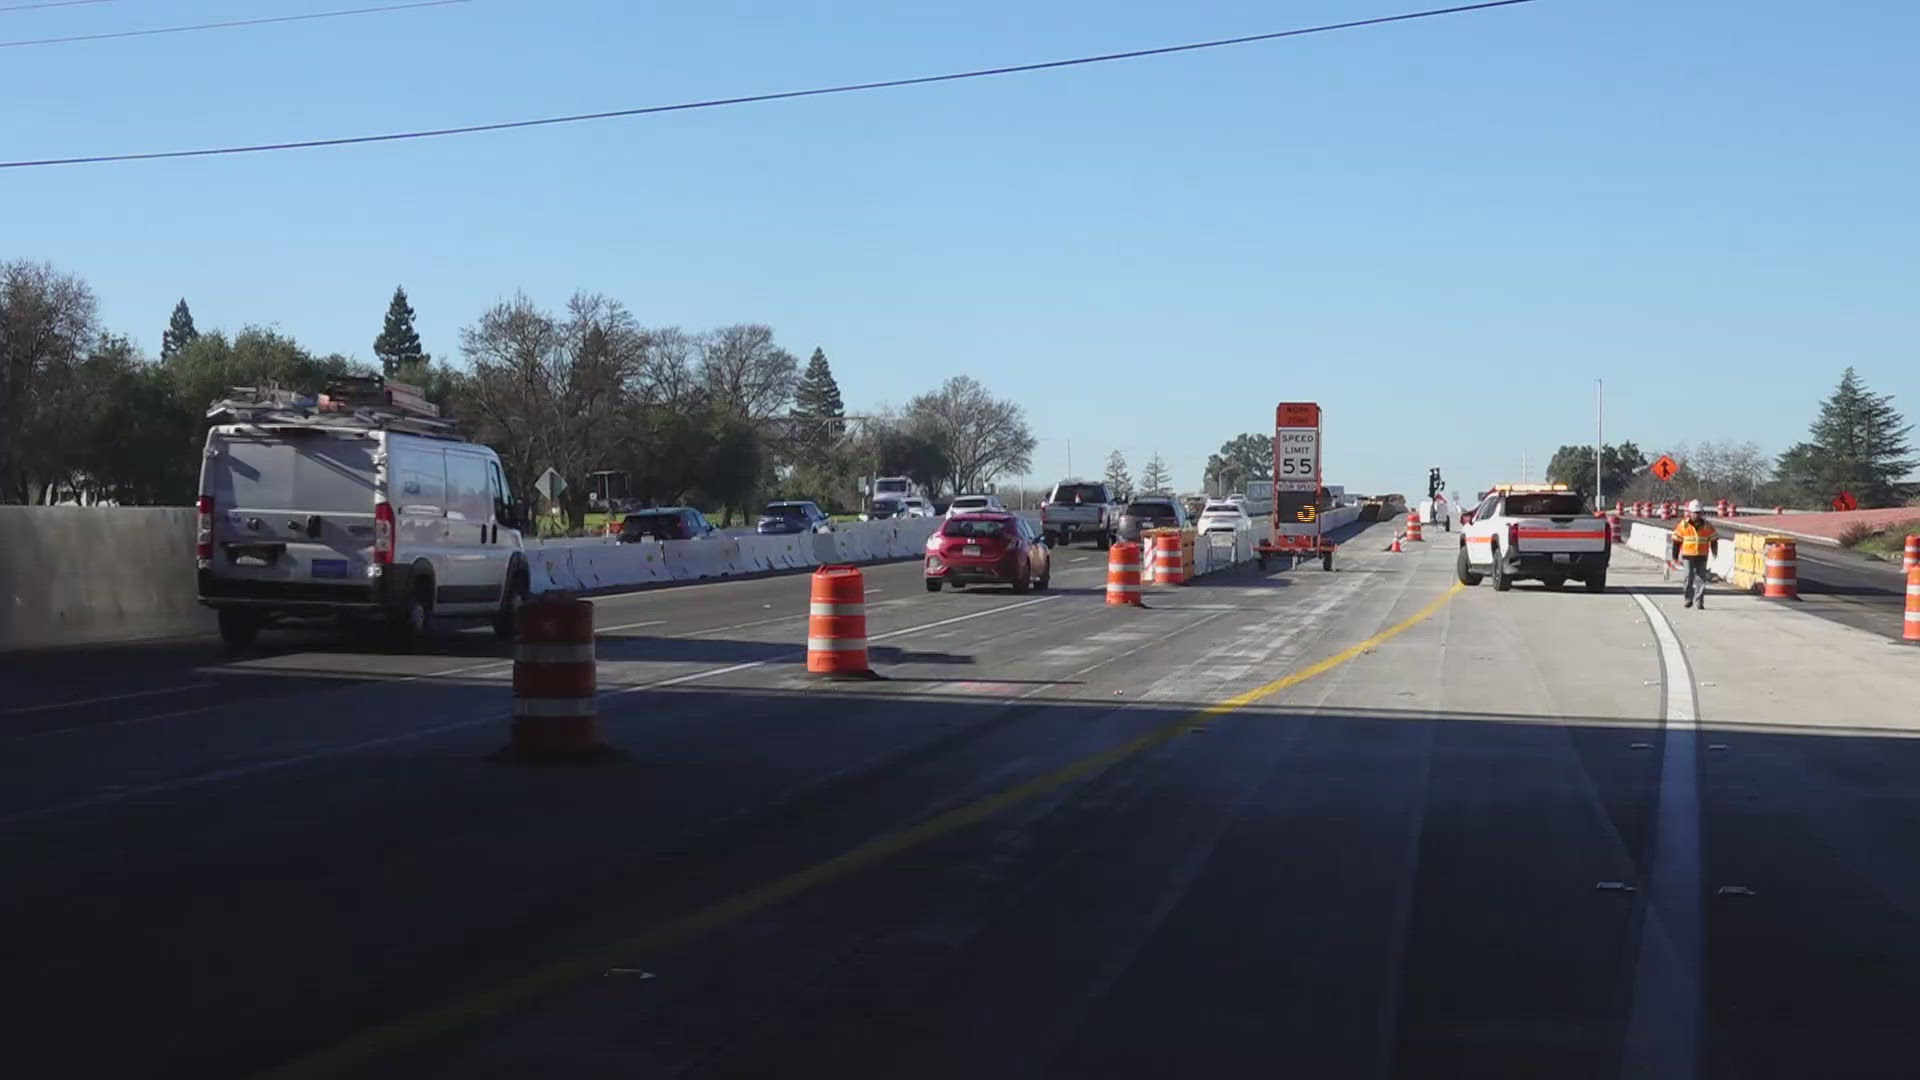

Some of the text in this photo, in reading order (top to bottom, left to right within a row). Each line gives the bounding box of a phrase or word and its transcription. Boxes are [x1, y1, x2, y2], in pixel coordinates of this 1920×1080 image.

[1282, 434, 1314, 443] SPEED
[1285, 446, 1310, 454] LIMIT
[1283, 458, 1312, 474] 55
